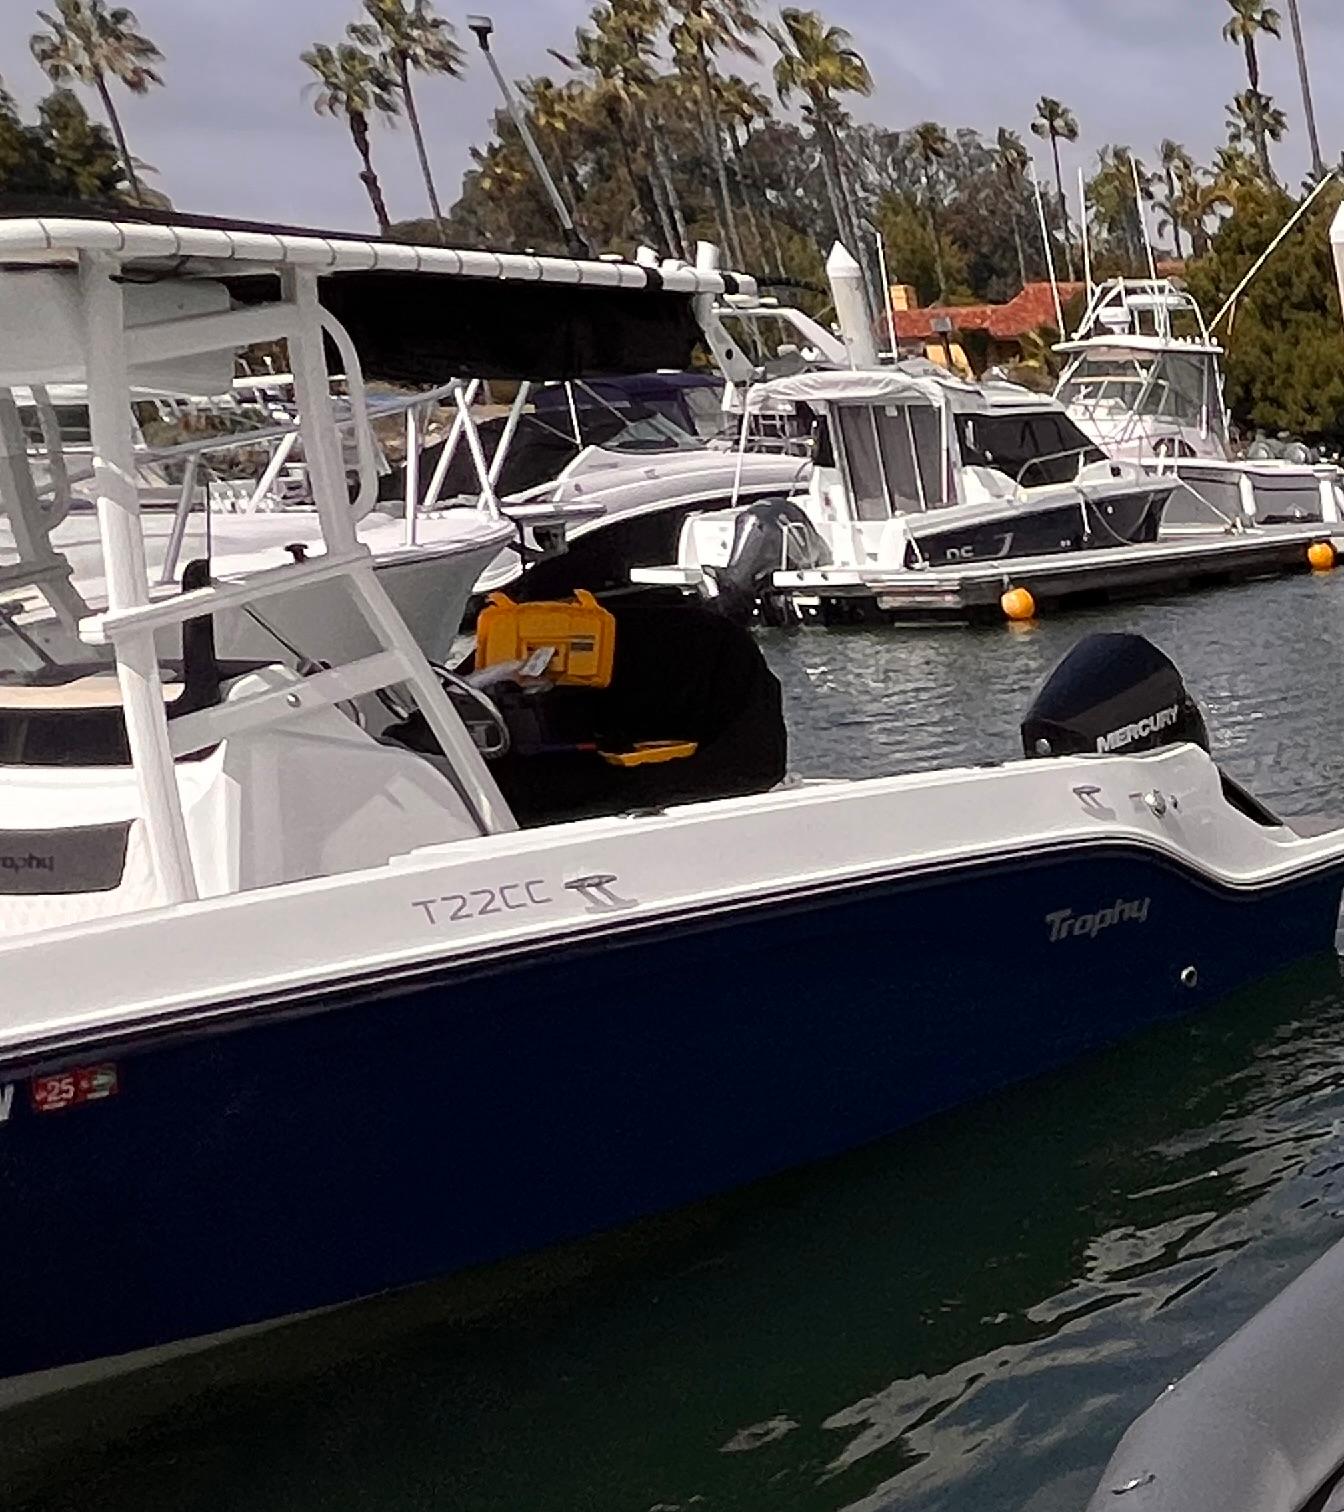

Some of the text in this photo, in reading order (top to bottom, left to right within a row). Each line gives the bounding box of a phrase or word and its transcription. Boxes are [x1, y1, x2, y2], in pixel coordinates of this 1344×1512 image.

[1096, 704, 1178, 752] MERCURY
[411, 880, 553, 925] T22CC
[1045, 897, 1151, 942] Trophy
[46, 1078, 75, 1102] 25
